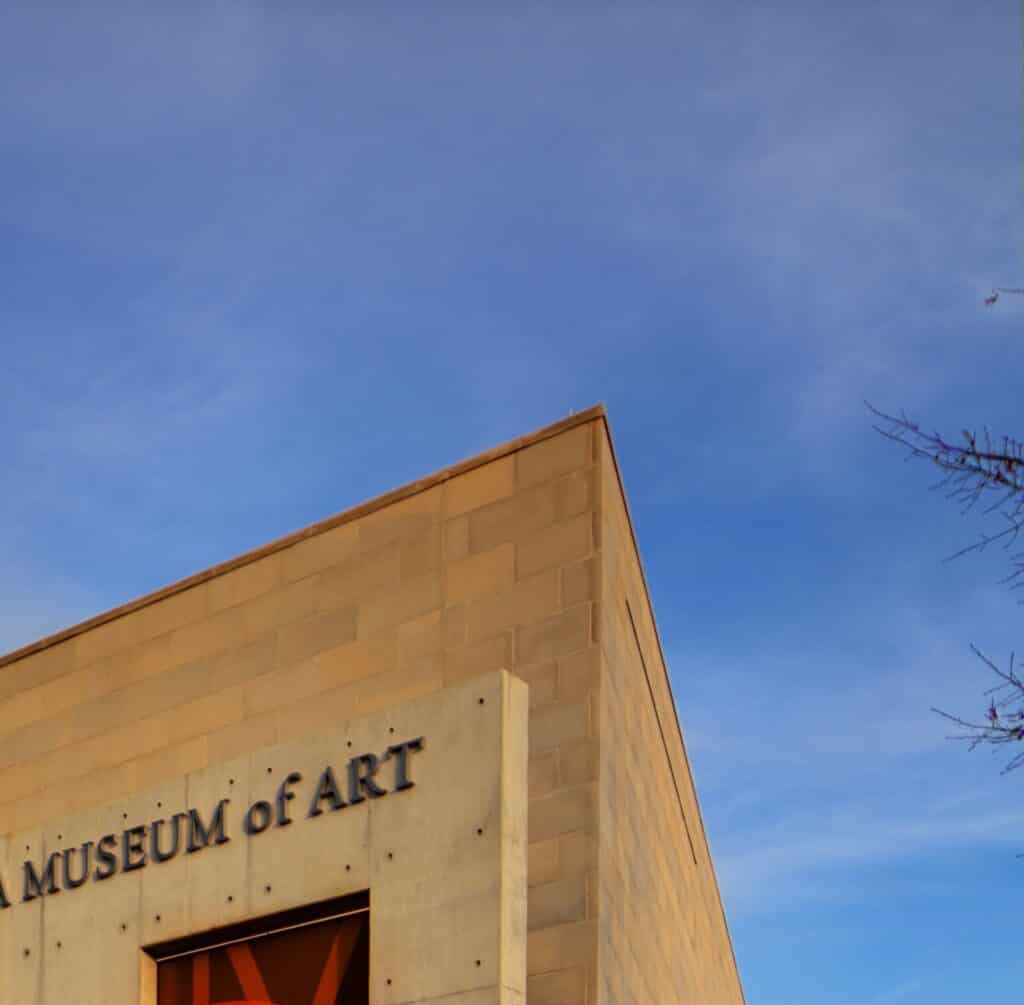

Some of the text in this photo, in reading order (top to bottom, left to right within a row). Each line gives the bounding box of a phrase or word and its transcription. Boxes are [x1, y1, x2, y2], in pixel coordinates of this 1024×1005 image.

[22, 797, 233, 903] MUSEUM
[243, 771, 302, 837] of
[308, 736, 425, 818] ART
